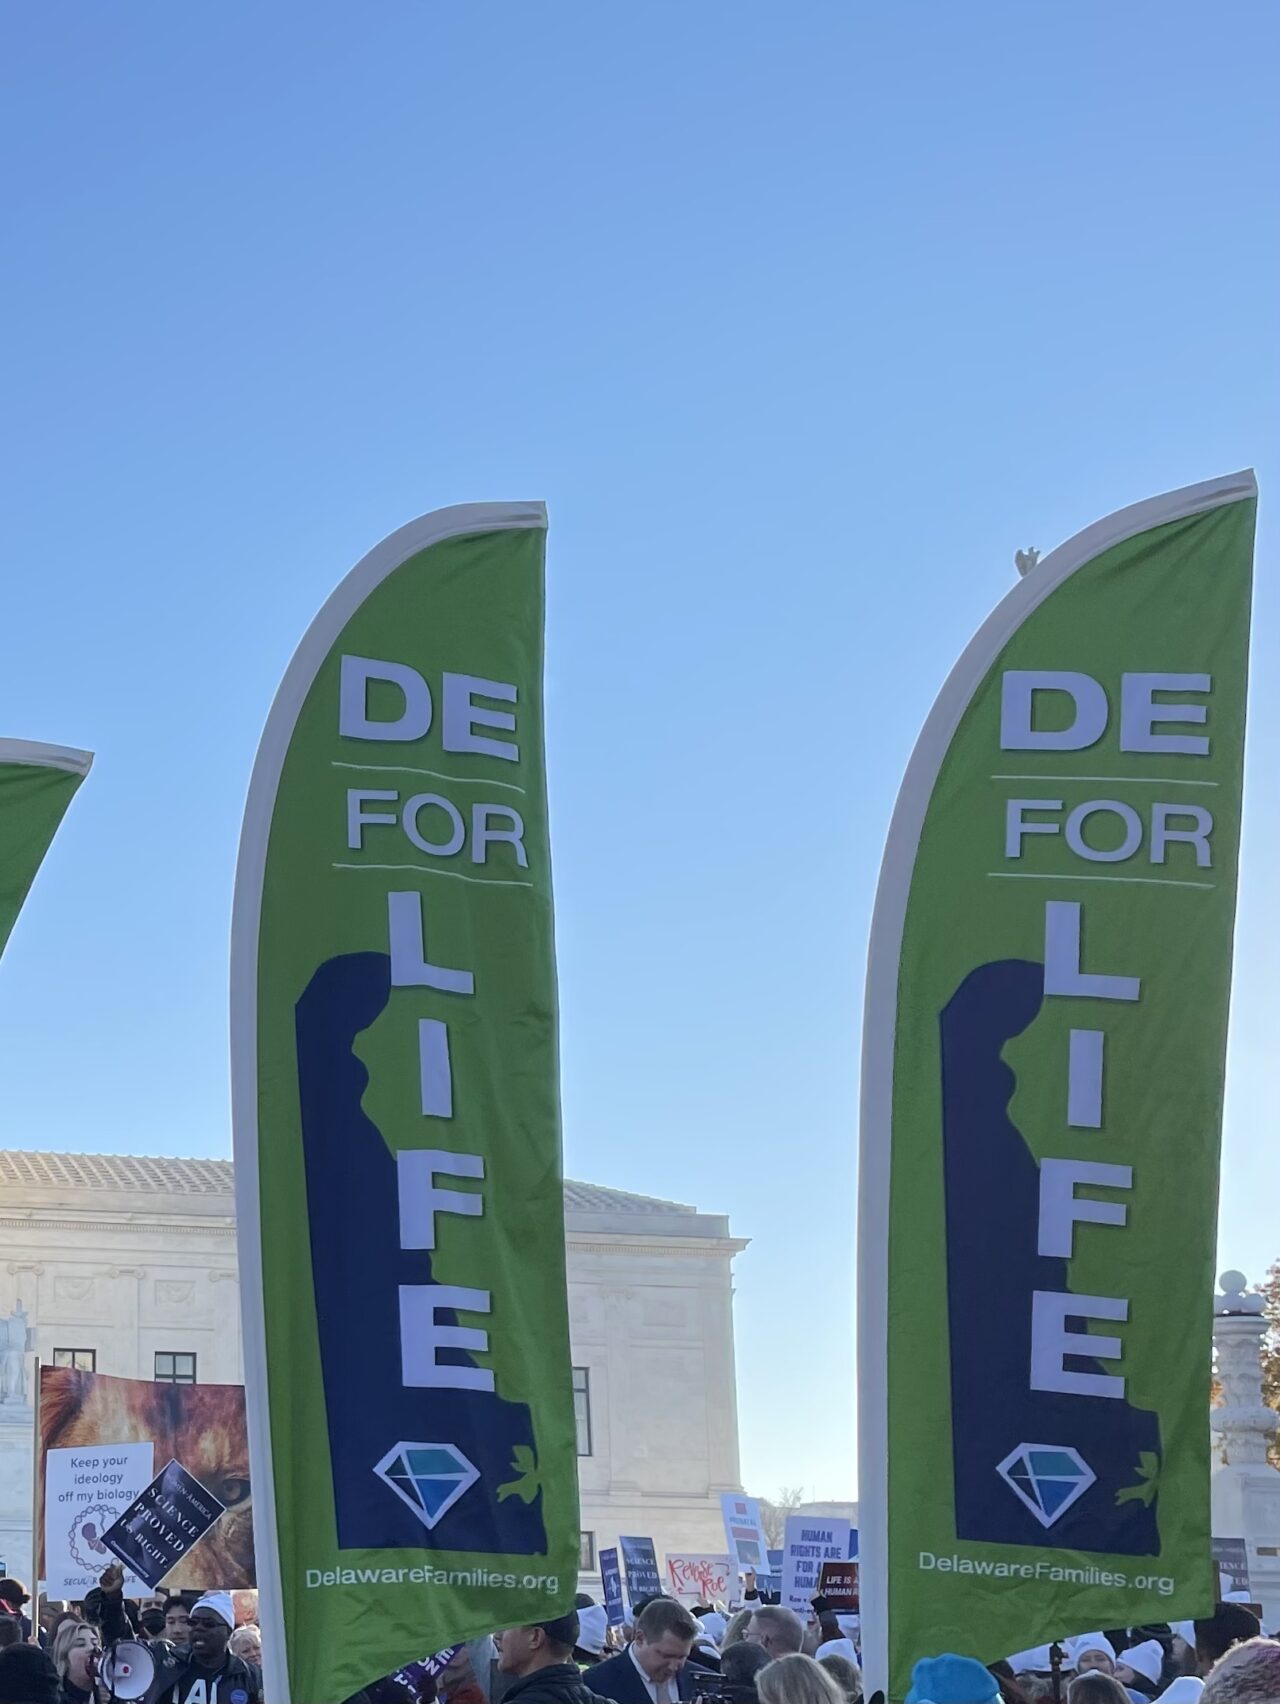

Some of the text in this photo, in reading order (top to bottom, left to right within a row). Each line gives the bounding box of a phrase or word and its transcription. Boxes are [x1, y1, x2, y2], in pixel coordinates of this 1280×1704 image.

[339, 654, 519, 762] DE
[1000, 670, 1211, 755] DE
[347, 788, 529, 868] FOR
[1005, 799, 1214, 867] FOR
[388, 891, 496, 1392] LIFE
[1030, 900, 1141, 1399] LIFE
[70, 1457, 128, 1469] Keep your
[74, 1473, 123, 1485] ideology
[58, 1489, 139, 1503] off my biology
[134, 1502, 184, 1552] PROVED
[148, 1488, 199, 1537] SCIENCE
[135, 1533, 168, 1568] RIGHT.
[801, 1529, 833, 1543] HUMAN
[790, 1544, 842, 1559] RIGHTS ARE
[63, 1577, 98, 1586] SECULR
[306, 1565, 559, 1594] DelawareFamilies.org
[668, 1559, 714, 1588] Reverse
[796, 1561, 813, 1573] FOR
[826, 1575, 842, 1584] LIFE
[843, 1575, 851, 1584] IS
[920, 1551, 1175, 1596] DelawareFamilies.org
[701, 1576, 727, 1599] Roe
[824, 1587, 852, 1596] HUMAN
